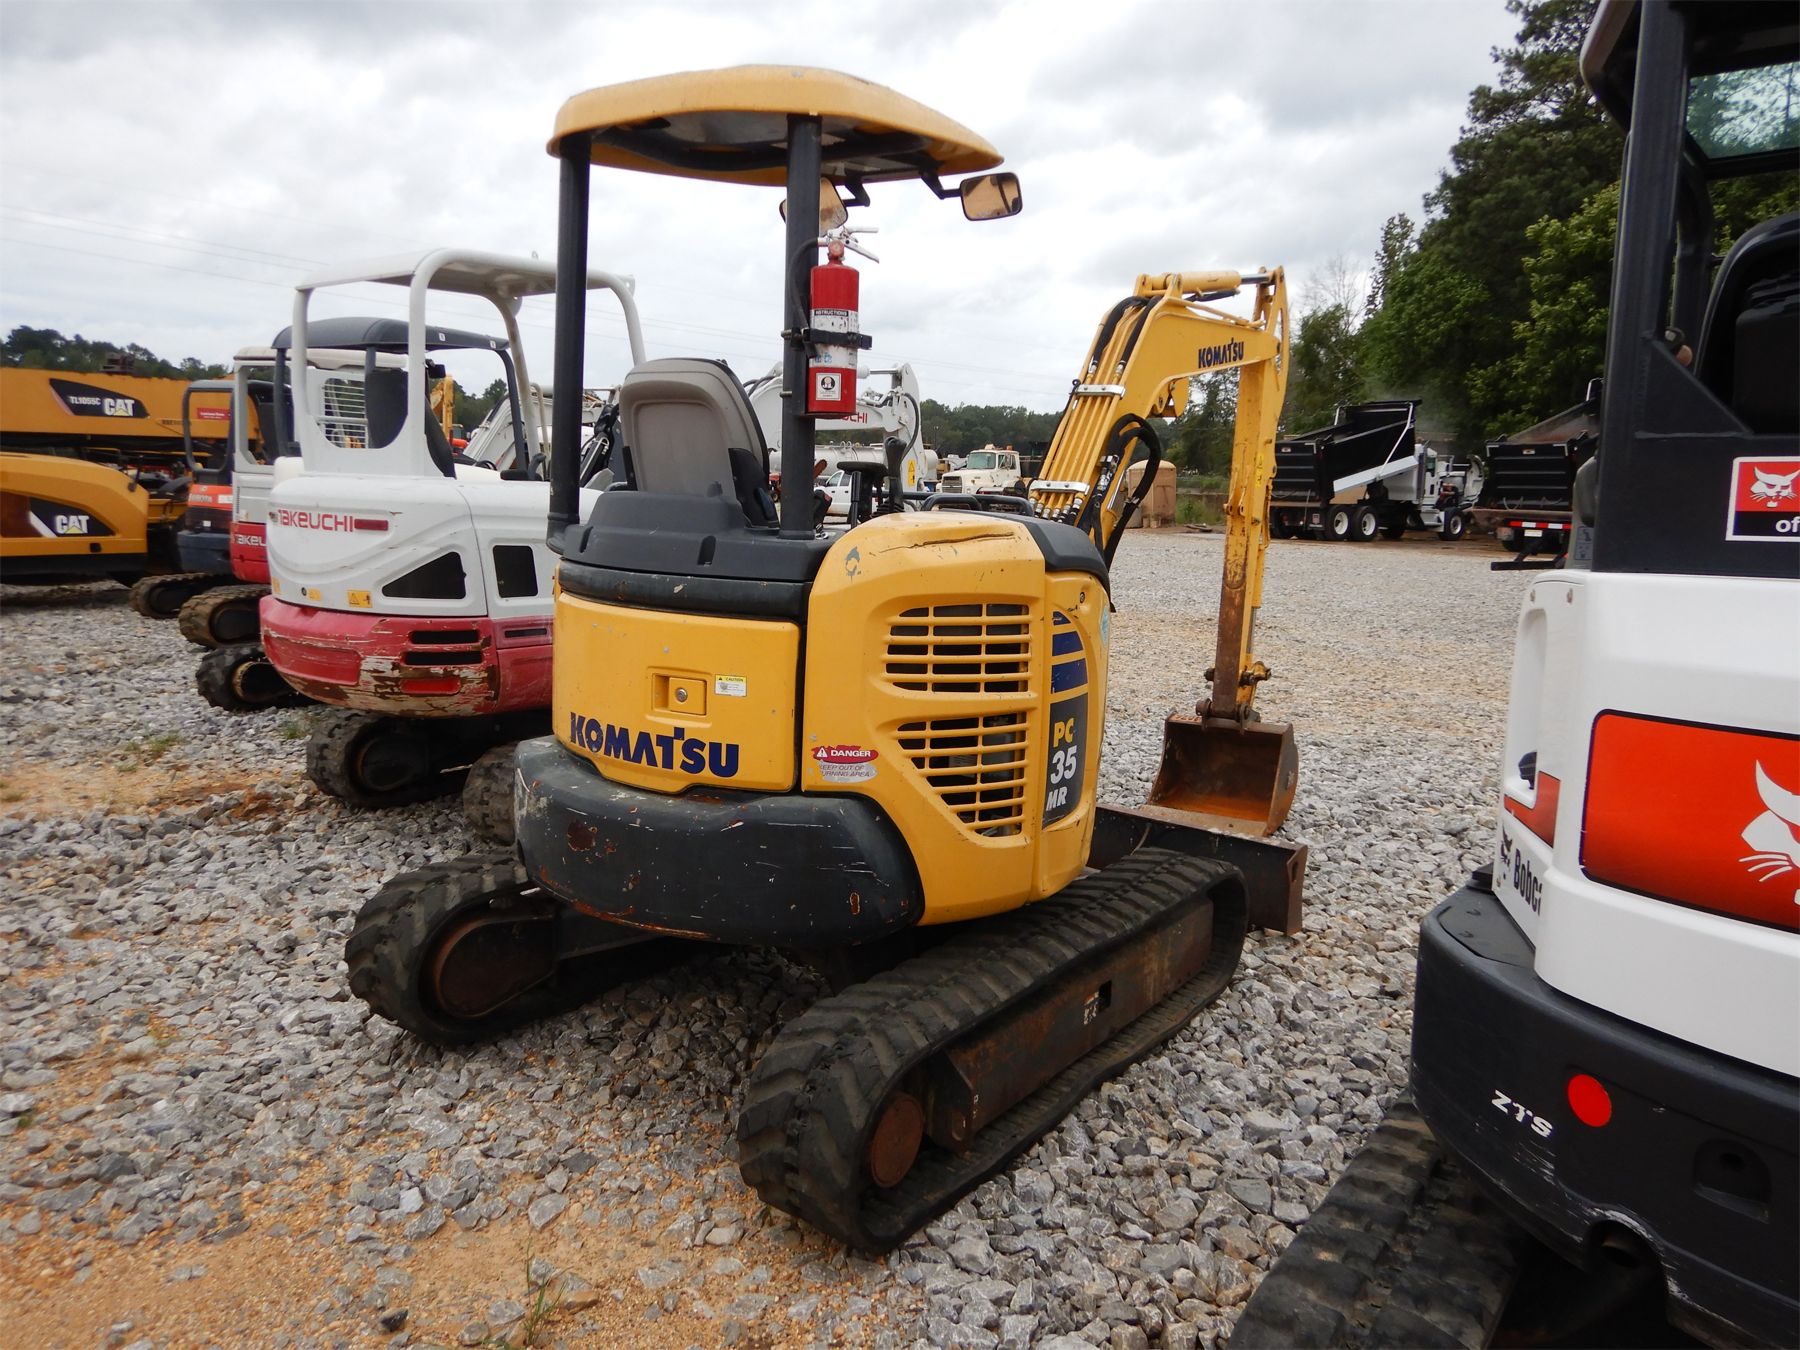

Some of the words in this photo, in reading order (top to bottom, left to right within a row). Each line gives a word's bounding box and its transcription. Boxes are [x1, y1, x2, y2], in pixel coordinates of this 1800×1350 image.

[1198, 337, 1245, 369] KOMATSU
[103, 398, 135, 417] CAT
[55, 515, 90, 535] CAT
[1775, 516, 1800, 533] of
[570, 712, 740, 778] KOMATSU
[1053, 717, 1075, 748] PC
[830, 749, 871, 757] DANGER
[1050, 745, 1077, 785] 35
[1045, 786, 1067, 812] MR
[1491, 1089, 1553, 1138] ZTS
